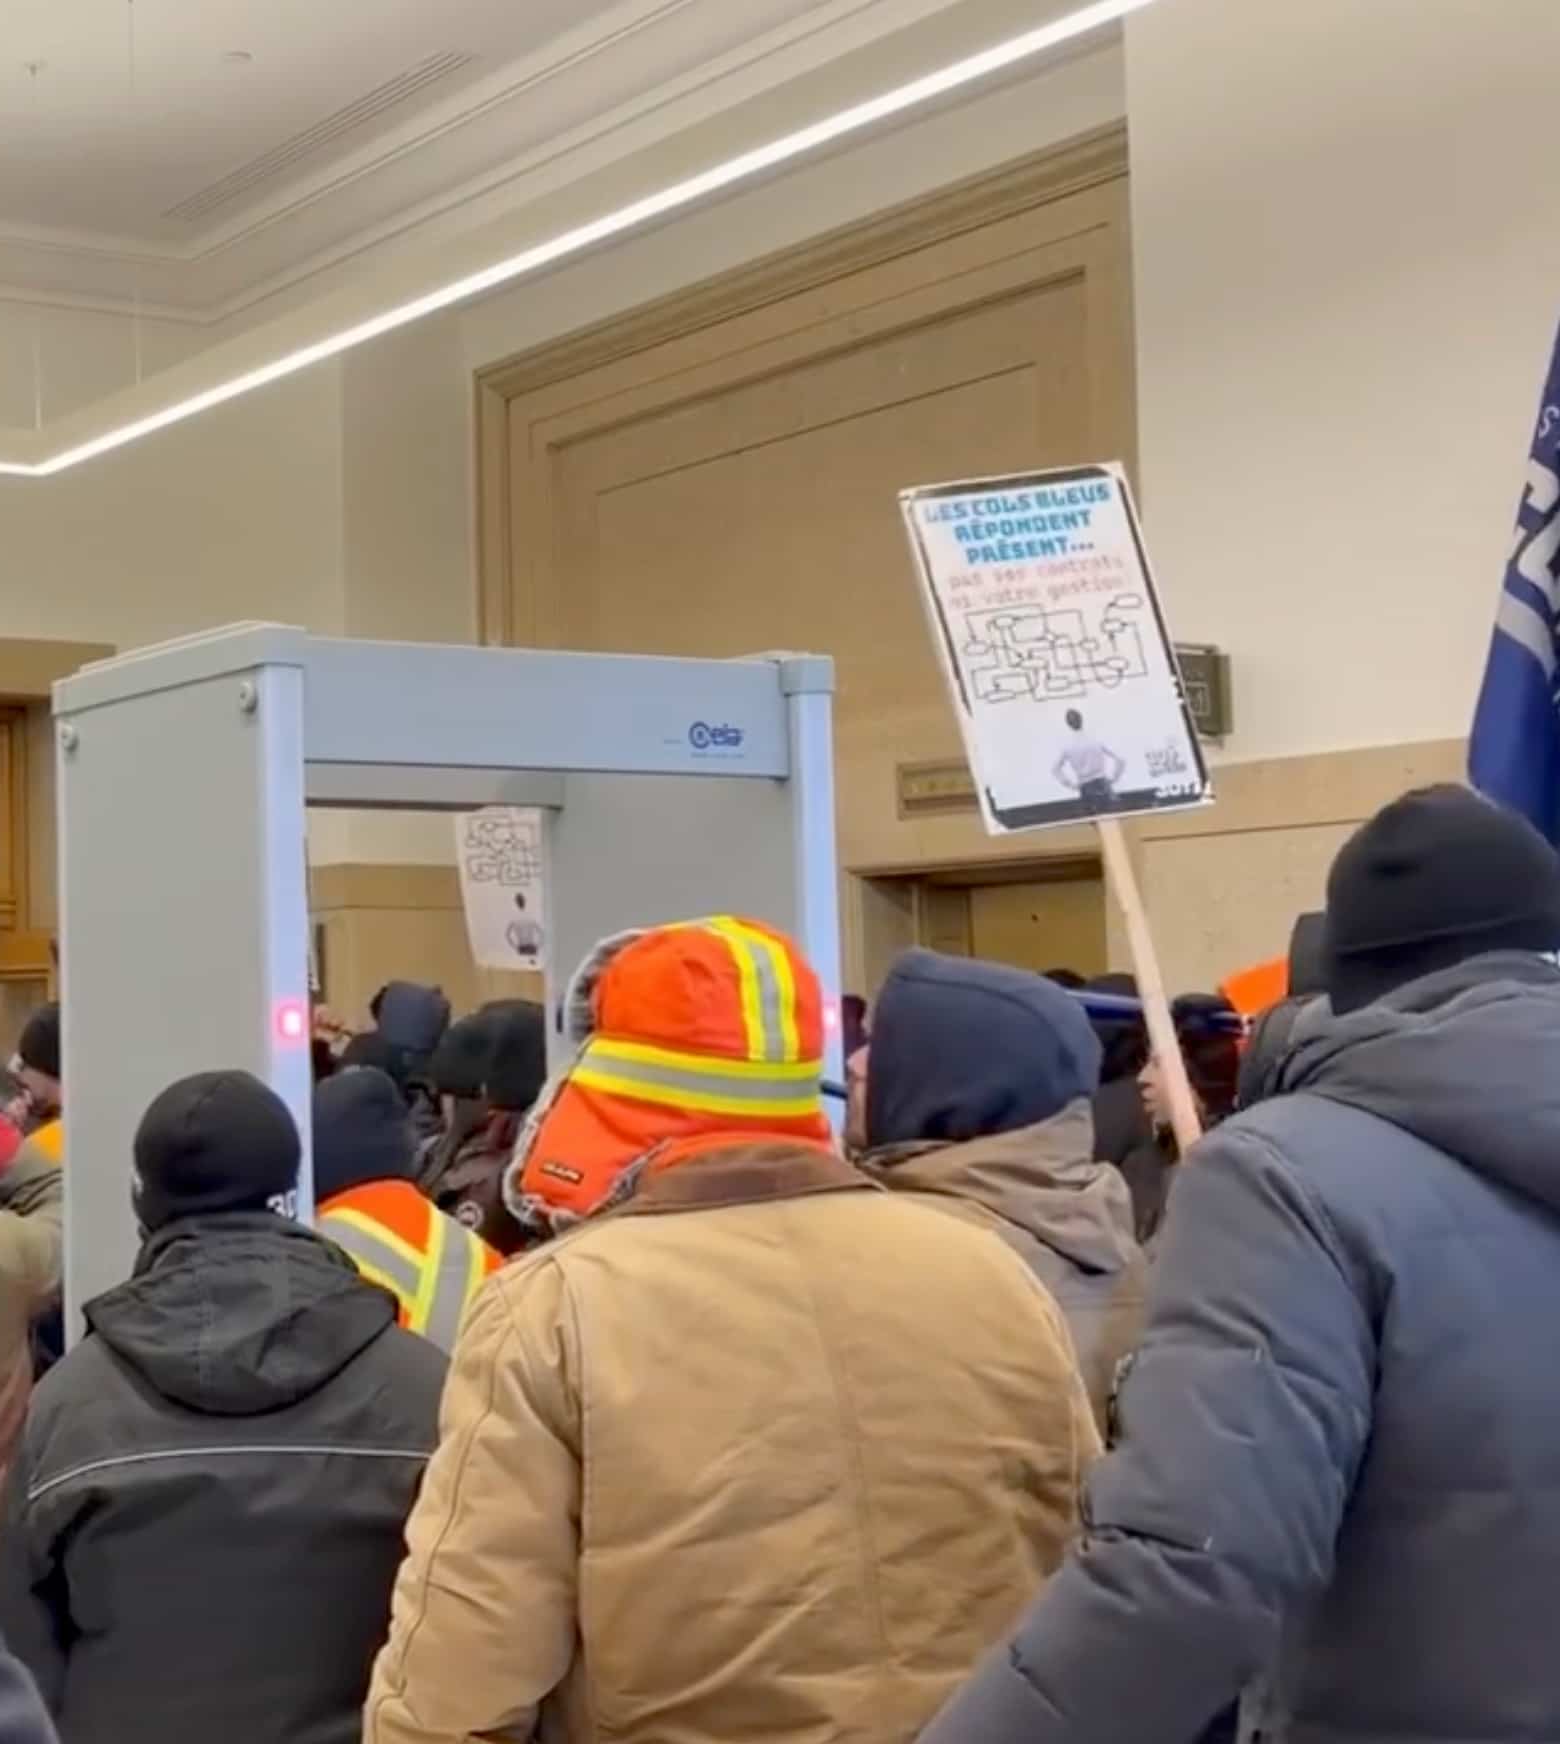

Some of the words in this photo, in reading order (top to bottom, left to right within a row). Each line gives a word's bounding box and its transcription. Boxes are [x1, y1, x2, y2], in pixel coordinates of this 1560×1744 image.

[925, 503, 967, 522] LES
[972, 493, 1032, 517] COLS
[1035, 483, 1110, 507] BLEUS
[954, 509, 1091, 542] RÉPONDENT
